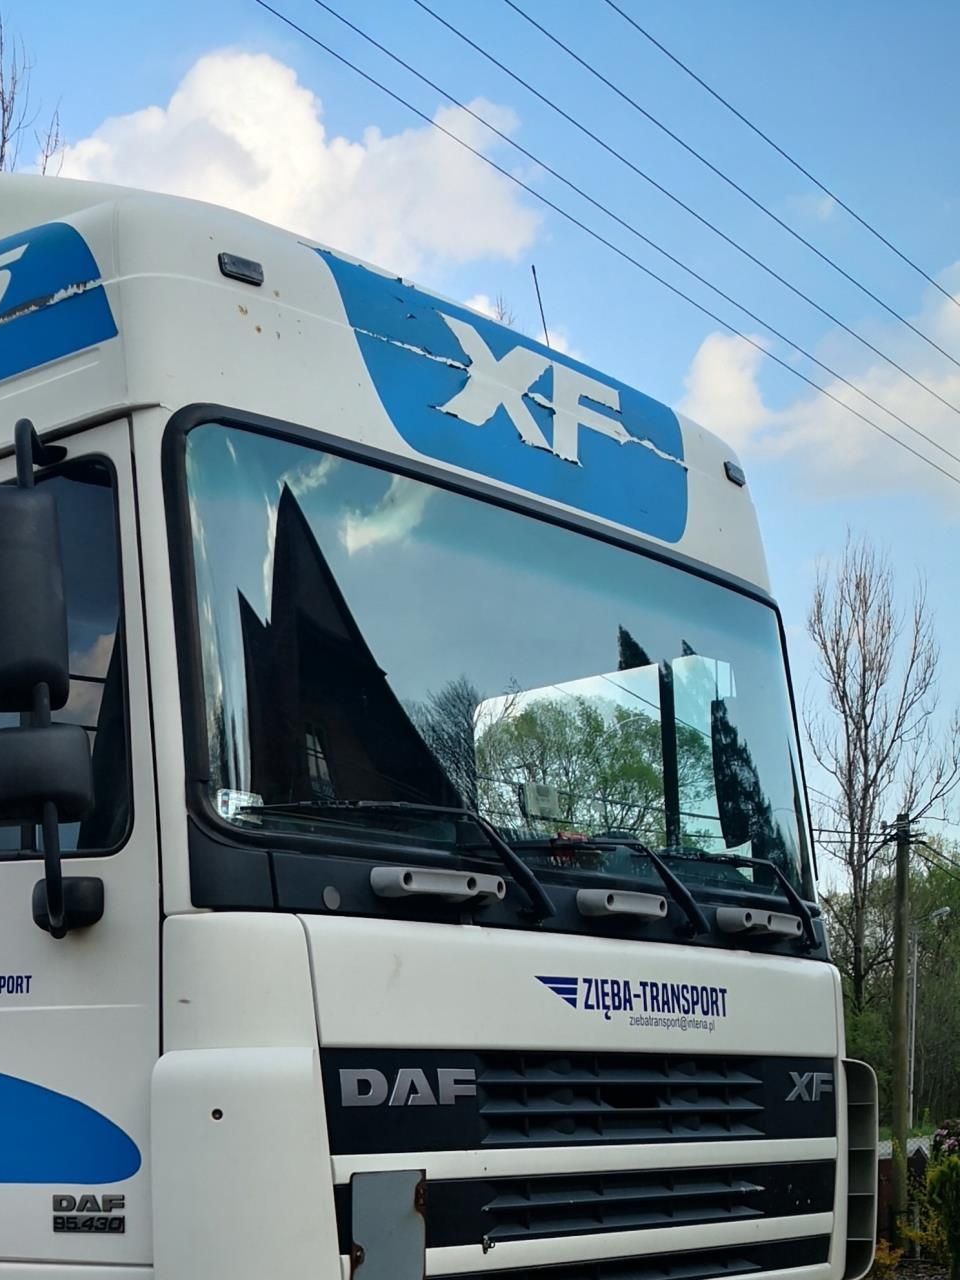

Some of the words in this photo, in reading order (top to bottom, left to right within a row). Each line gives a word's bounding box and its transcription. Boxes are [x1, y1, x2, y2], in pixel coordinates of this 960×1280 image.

[437, 311, 626, 466] XF
[582, 977, 728, 1021] ZIĘBA-TRANSPORT
[338, 1068, 477, 1107] DAF
[785, 1071, 833, 1102] XF
[52, 1194, 126, 1213] DAF
[53, 1215, 123, 1232] 95.430
